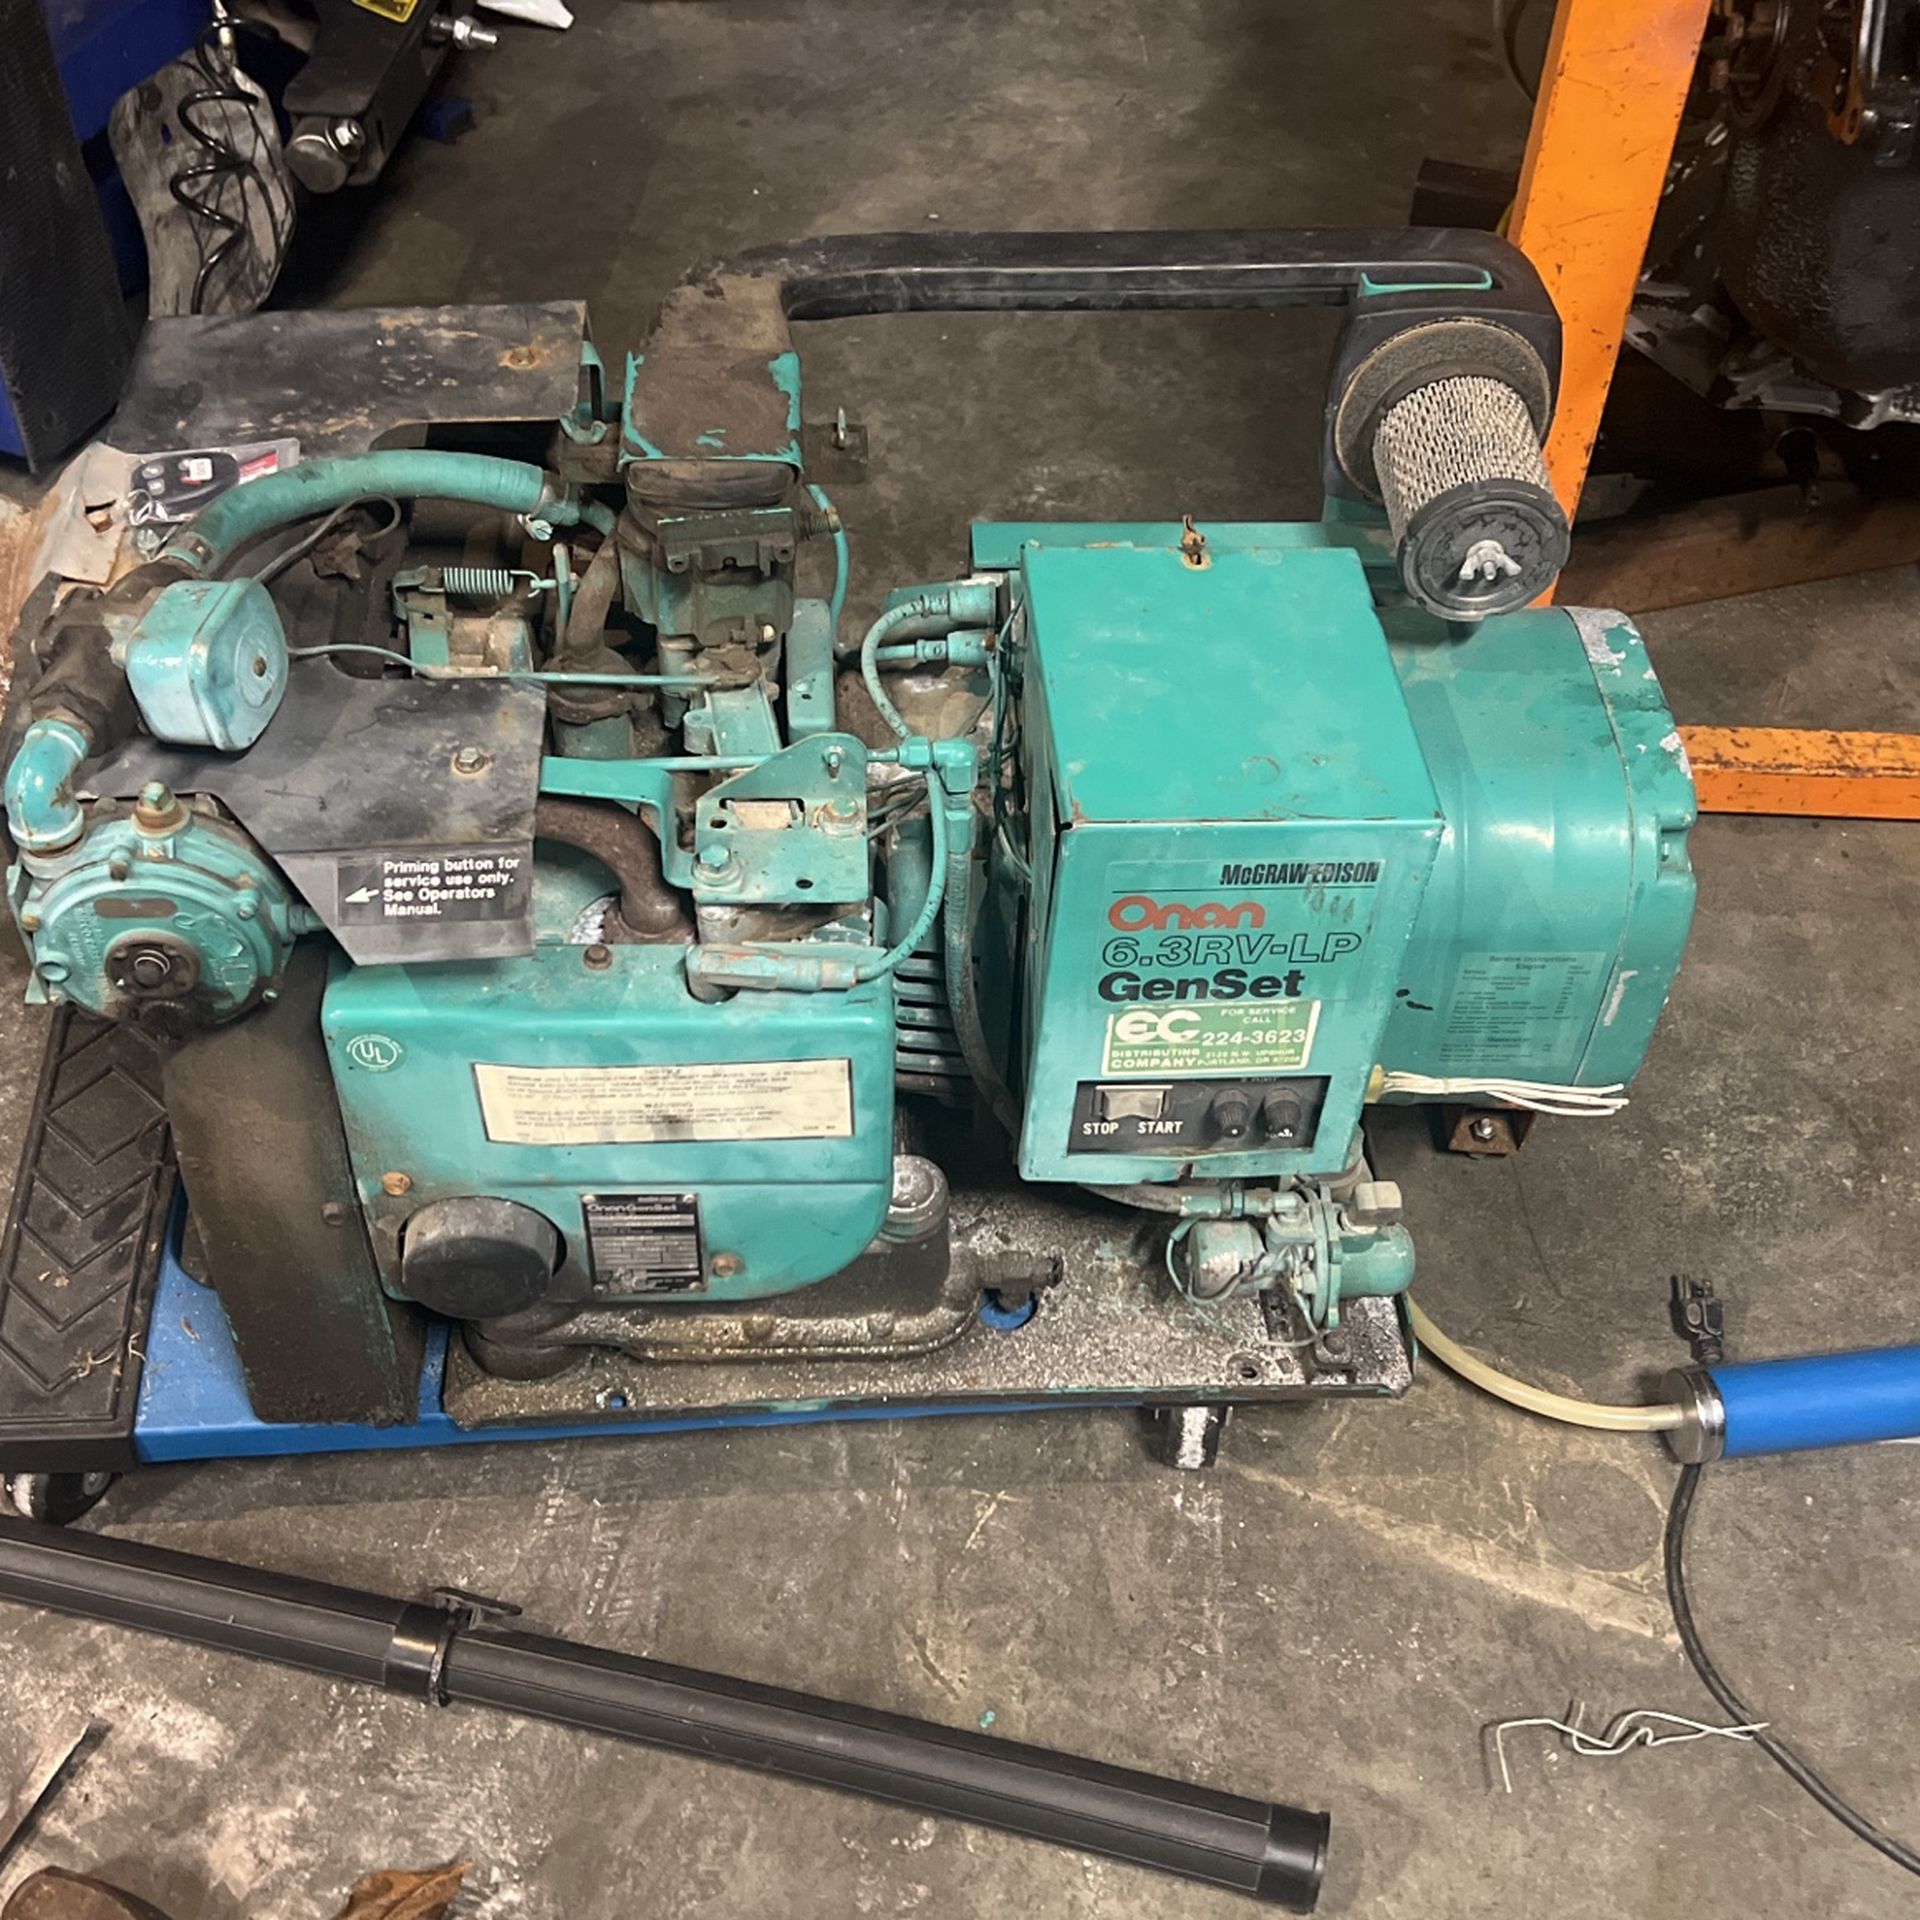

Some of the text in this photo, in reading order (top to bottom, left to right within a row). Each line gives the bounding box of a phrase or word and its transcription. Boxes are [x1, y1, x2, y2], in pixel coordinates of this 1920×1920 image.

[384, 856, 520, 875] Priming button for
[384, 871, 515, 888] service use only.
[384, 887, 496, 903] See Operators
[384, 903, 442, 917] Manual.
[1108, 895, 1266, 931] Onan
[1102, 932, 1363, 968] 6.3RV-LP
[1098, 968, 1306, 1002] GenSet
[1220, 1006, 1296, 1017] FOR SERVICE
[1242, 1016, 1272, 1025] CALL
[1201, 1028, 1306, 1047] 224-3623
[360, 1041, 389, 1063] UL
[1111, 1047, 1200, 1059] DISTRIBUTING
[1110, 1058, 1196, 1069] COMPANY
[1083, 1120, 1183, 1135] STOP START
